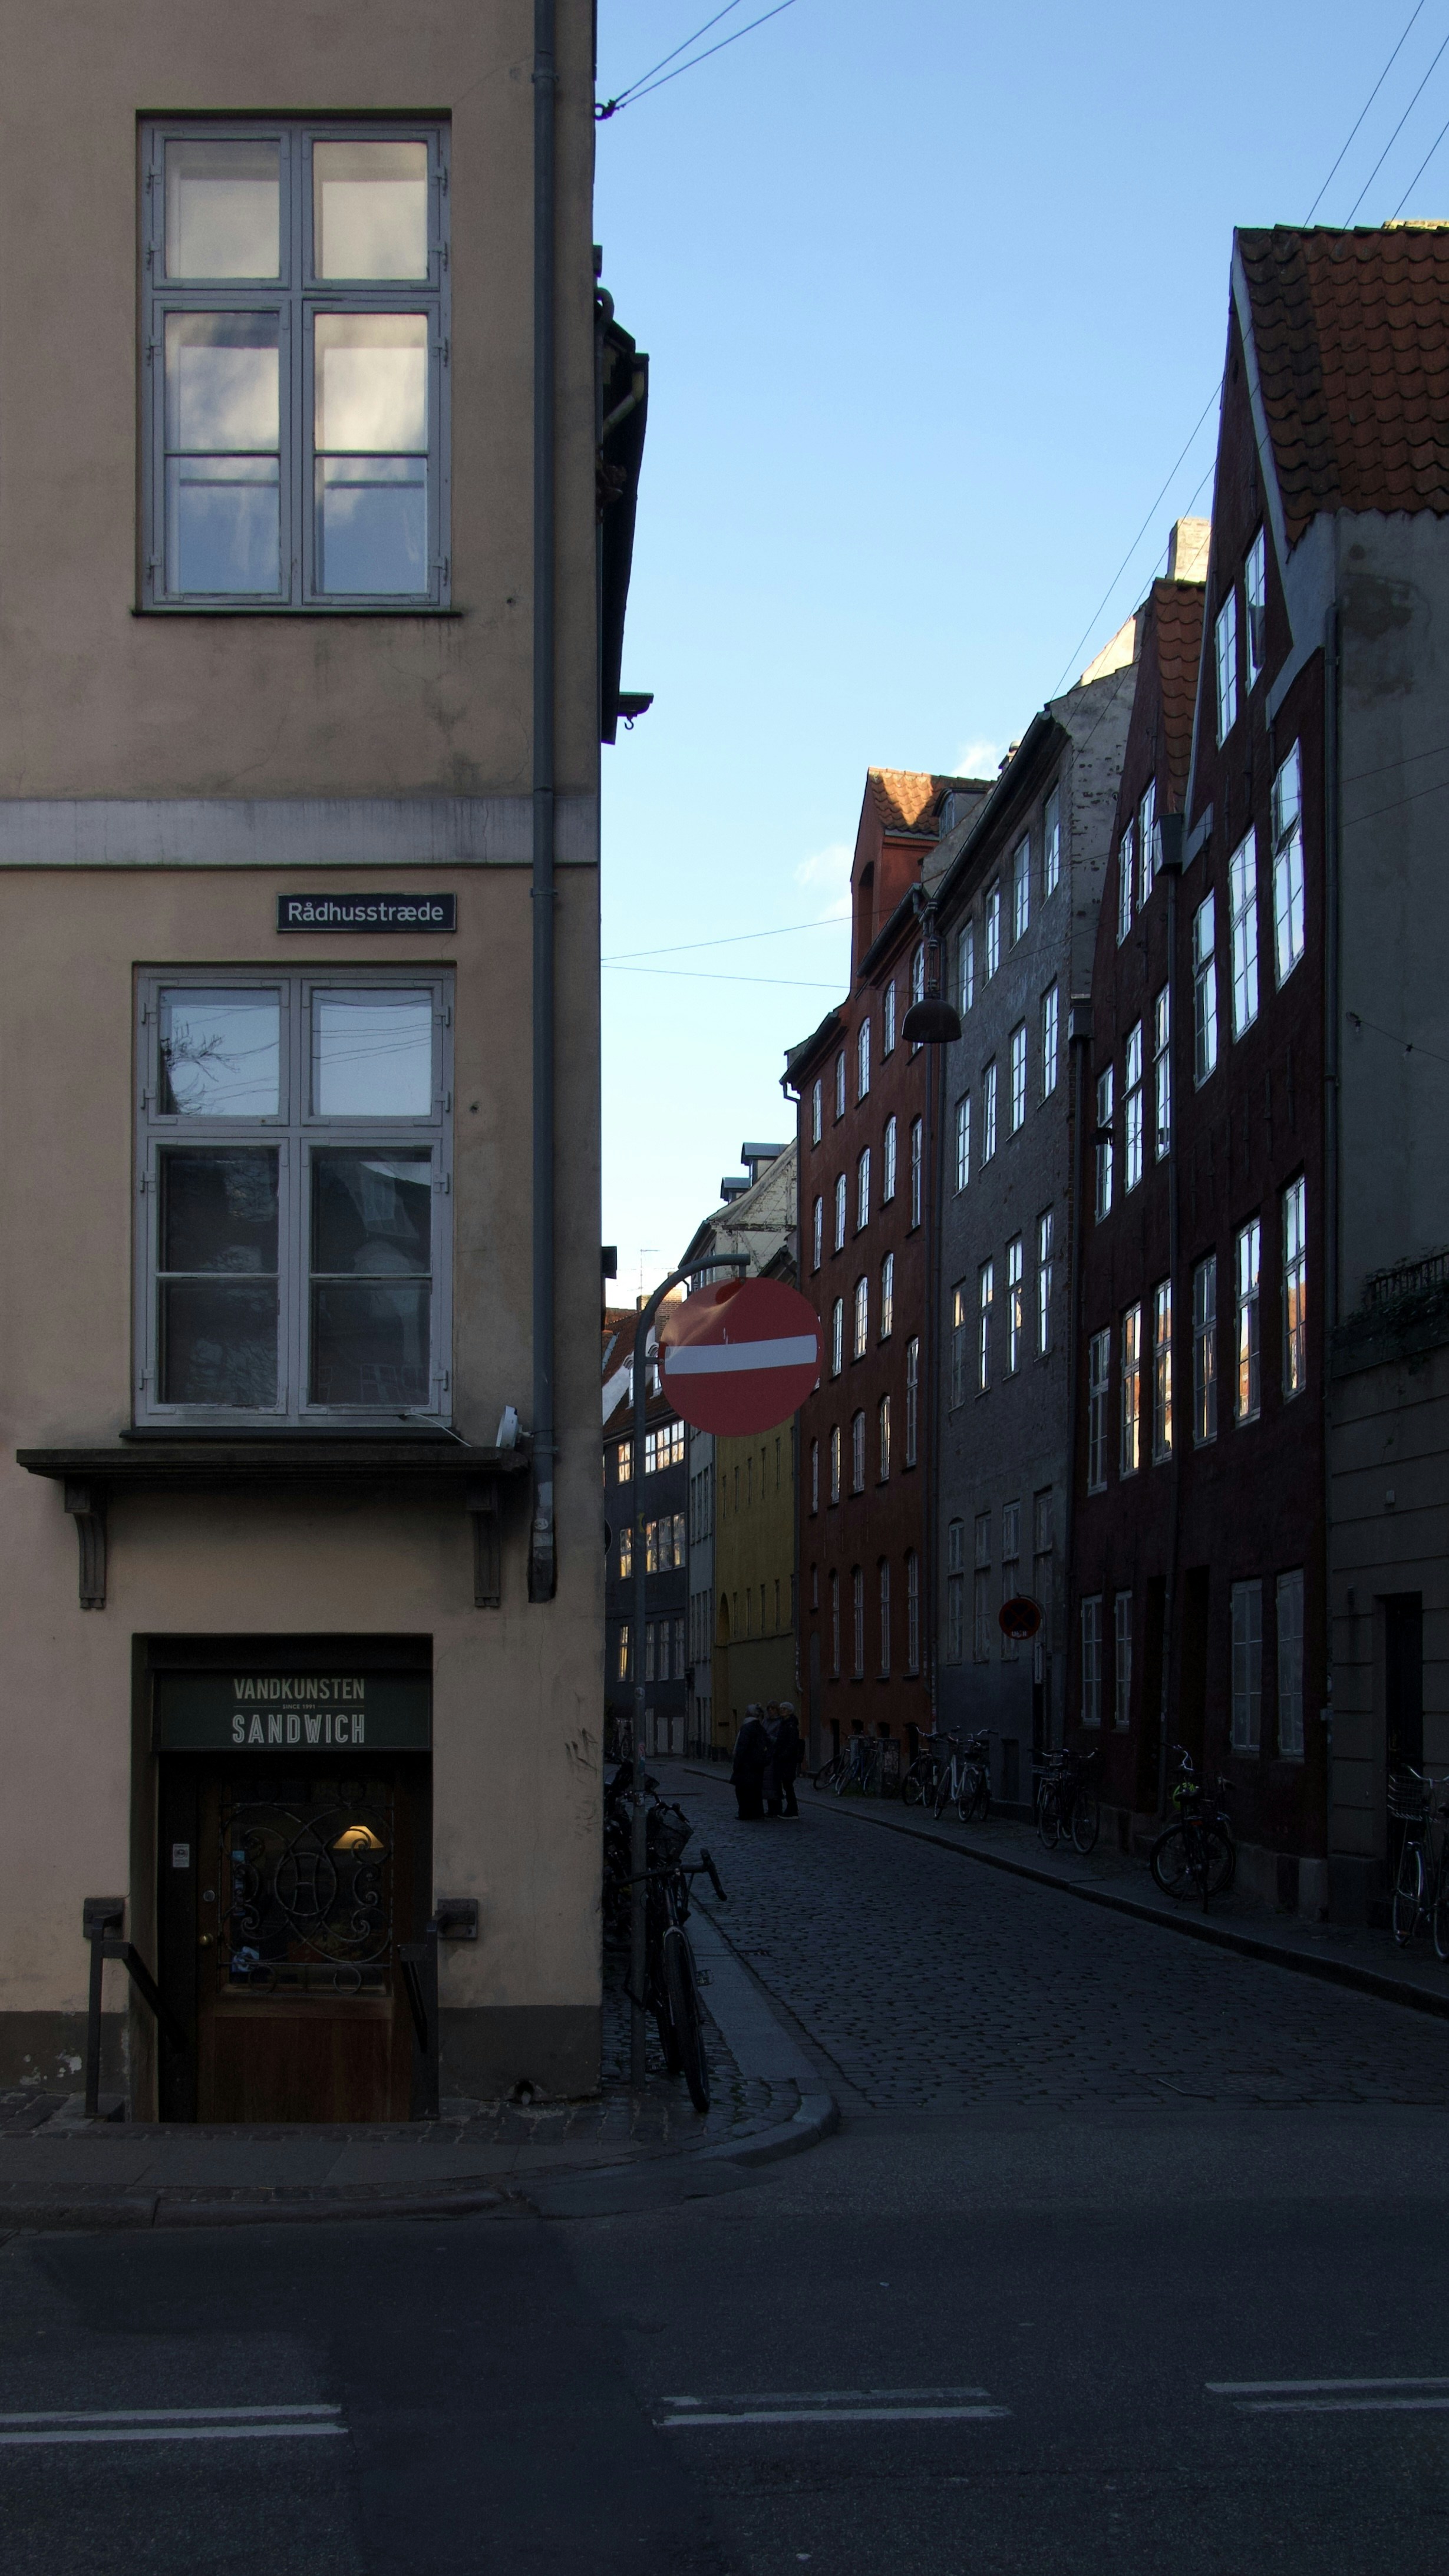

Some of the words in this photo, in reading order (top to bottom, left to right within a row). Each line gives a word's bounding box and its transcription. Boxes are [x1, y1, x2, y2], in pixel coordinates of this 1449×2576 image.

[288, 902, 444, 920] Rådhusstræde
[233, 1678, 364, 1699] VANDKUNSTEN
[232, 1714, 365, 1743] SANDWICH
